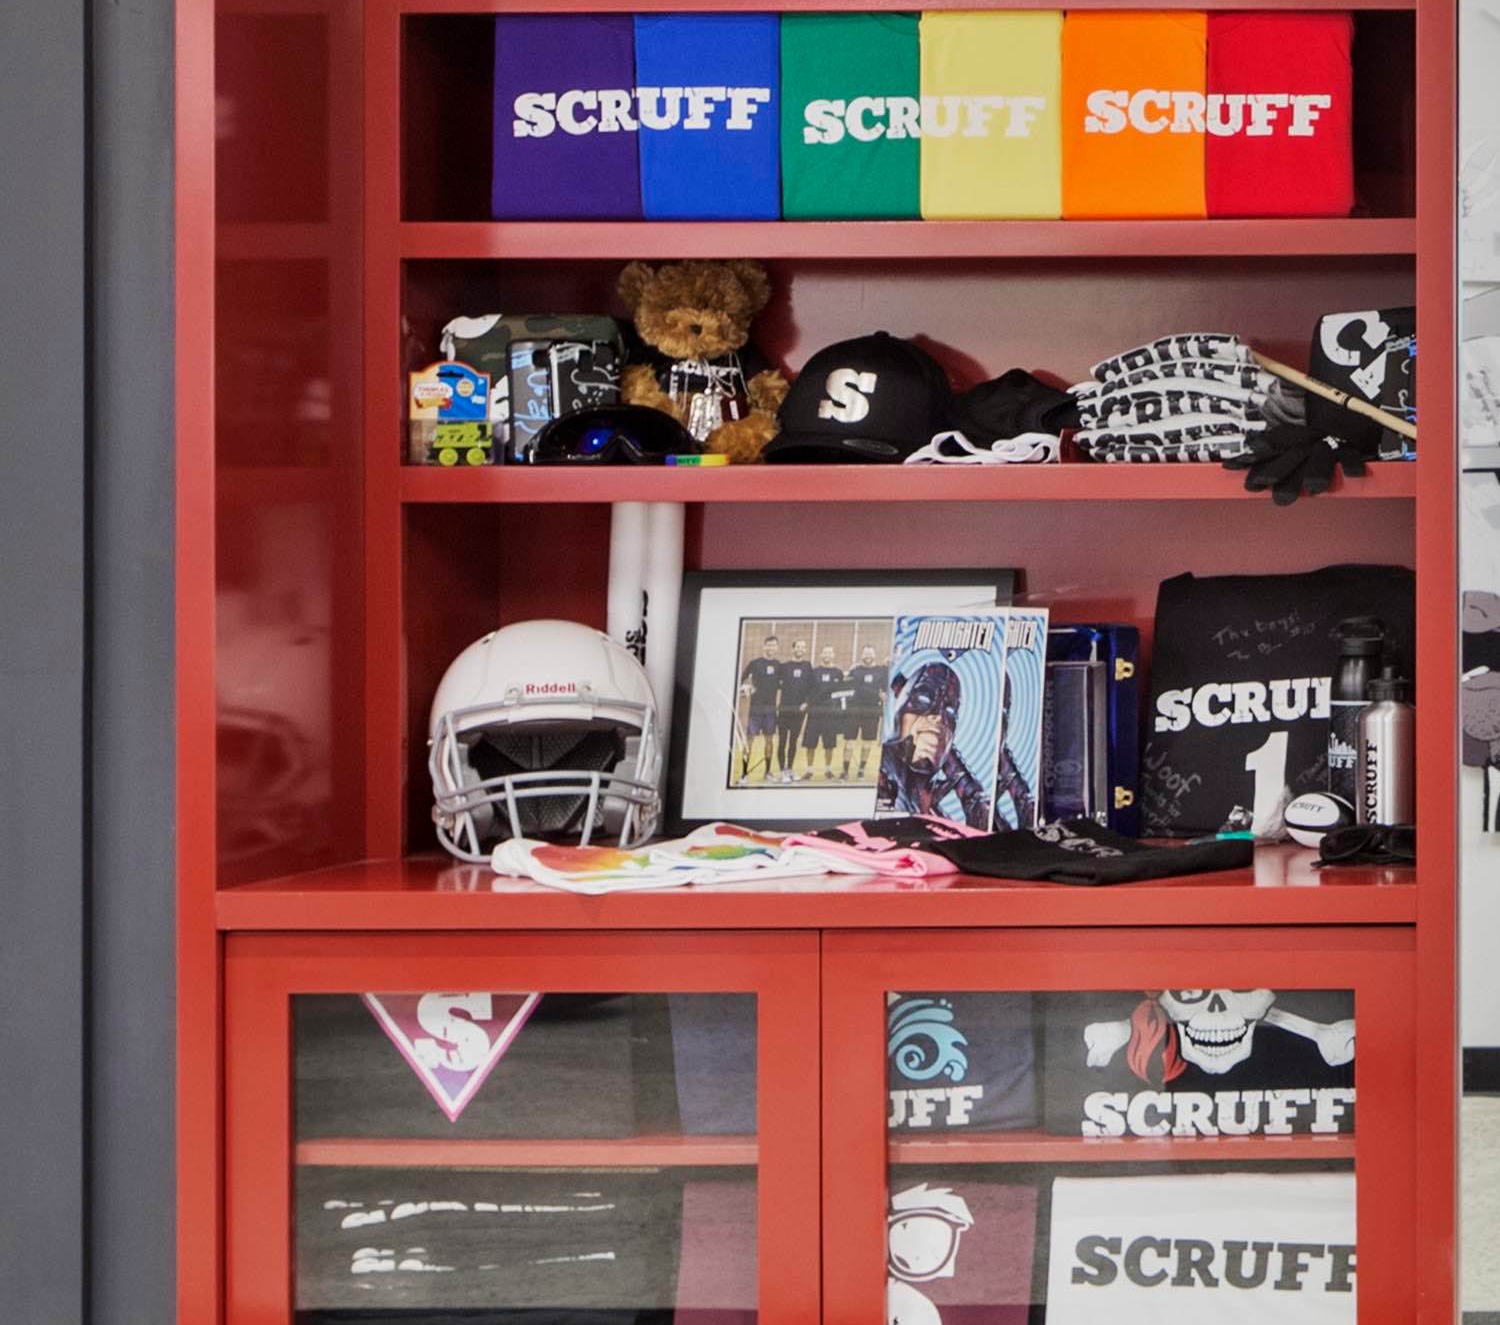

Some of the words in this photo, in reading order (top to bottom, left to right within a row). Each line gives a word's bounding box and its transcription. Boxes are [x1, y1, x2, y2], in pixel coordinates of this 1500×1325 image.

[513, 86, 770, 138] SCRUFF
[803, 95, 1046, 145] SCRUFF
[1084, 89, 1332, 137] SCRUFF
[818, 368, 877, 423] S
[525, 682, 576, 694] Riddell
[1155, 677, 1332, 733] SCRU
[1245, 731, 1289, 836] 1
[1365, 739, 1378, 825] SCRUFF
[414, 992, 493, 1072] S
[1081, 1088, 1355, 1137] SCRUFF
[1071, 1235, 1356, 1292] SCRUFF
